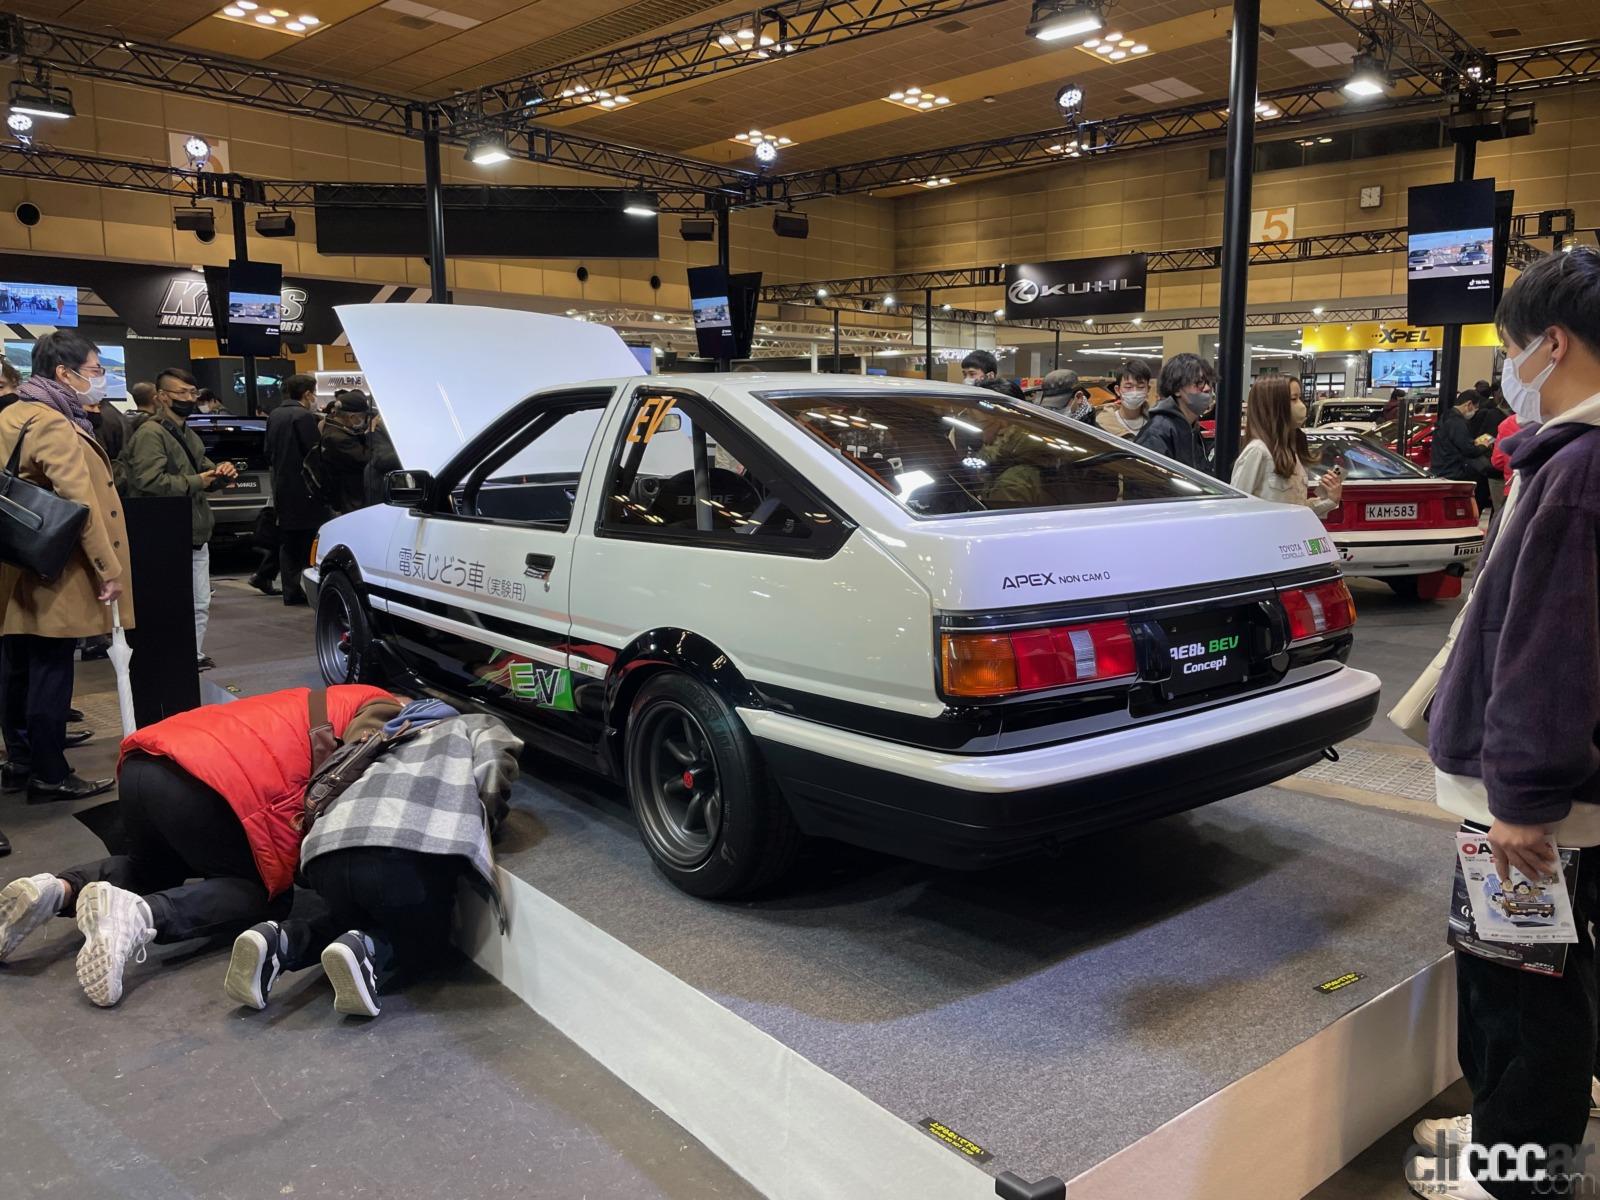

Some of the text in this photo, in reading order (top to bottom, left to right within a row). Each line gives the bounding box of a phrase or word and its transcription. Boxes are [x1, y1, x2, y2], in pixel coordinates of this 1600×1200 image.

[1040, 278, 1143, 297] KUHL
[161, 315, 189, 326] KOBE
[1378, 328, 1431, 344] XPEL
[626, 398, 678, 443] EV
[1279, 543, 1303, 553] TOYOTA
[1454, 540, 1484, 556] PIRELL
[398, 547, 487, 592] 電気じどう車
[1001, 572, 1057, 590] APEX
[1058, 575, 1081, 584] NON
[1082, 573, 1103, 582] CAM
[1208, 634, 1239, 653] BEV
[1183, 655, 1228, 675] Concept
[508, 662, 562, 706] EV
